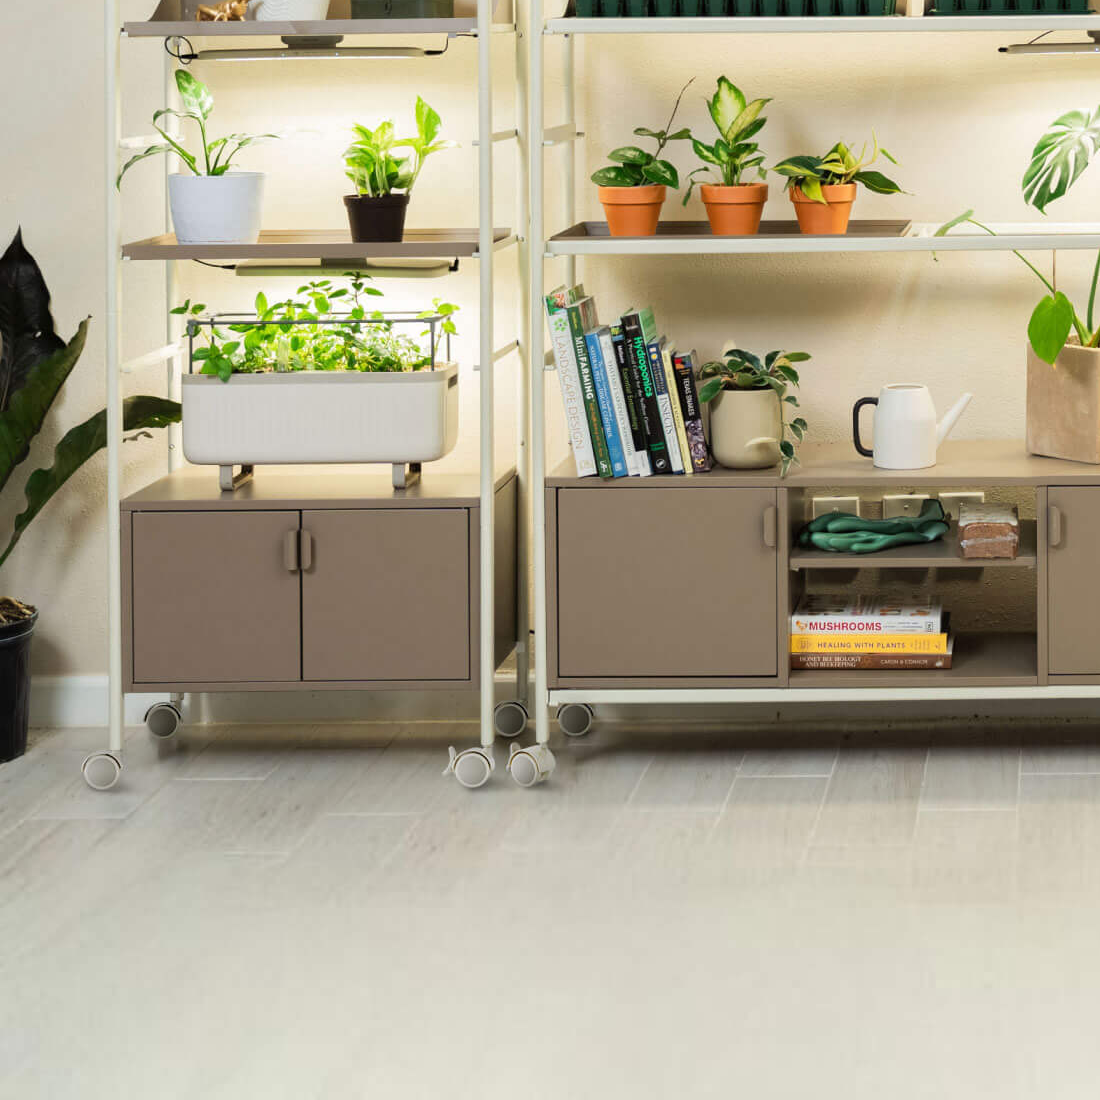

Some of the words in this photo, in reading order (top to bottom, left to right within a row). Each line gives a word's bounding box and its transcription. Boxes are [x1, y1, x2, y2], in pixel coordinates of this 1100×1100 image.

[633, 336, 653, 398] Hydroponics
[555, 335, 576, 403] LANDSCAPE
[569, 406, 584, 449] DESIGN
[683, 377, 691, 394] TEXAS
[660, 396, 673, 435] INSECTS
[686, 394, 694, 415] SNAKES
[809, 621, 882, 631] MUSHROOMS
